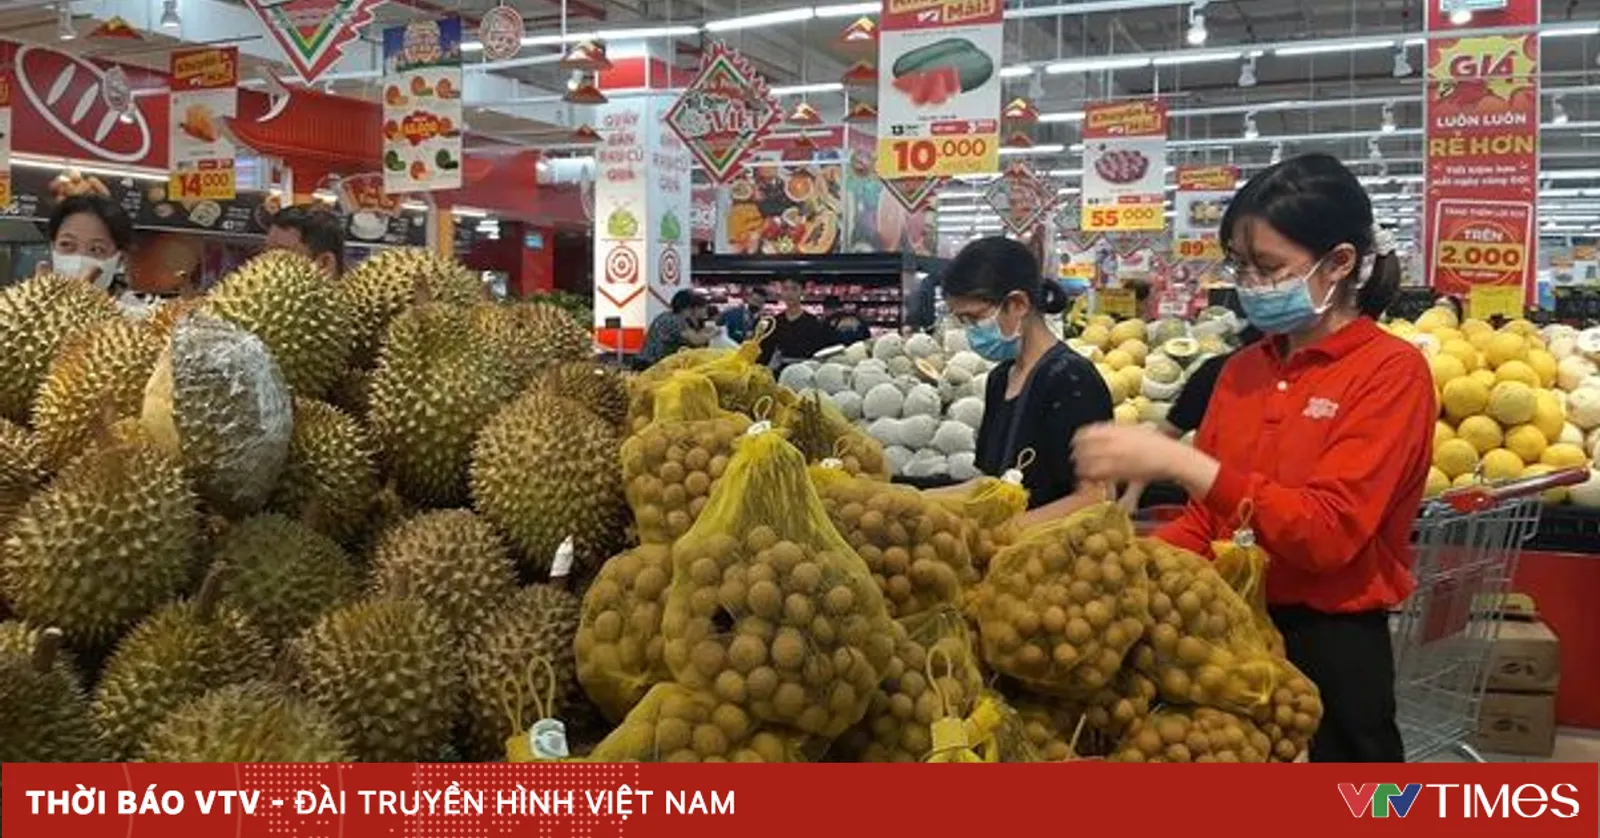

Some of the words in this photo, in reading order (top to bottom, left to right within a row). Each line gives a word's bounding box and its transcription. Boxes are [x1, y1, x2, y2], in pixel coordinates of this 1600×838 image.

[1450, 49, 1517, 78] GIÁ
[1437, 113, 1479, 128] LUÔN
[1482, 110, 1527, 126] LUÔN
[1430, 130, 1465, 157] RẺ
[1470, 134, 1534, 155] HƠN
[1464, 227, 1504, 242] TRÊN
[1439, 245, 1521, 267] 2.000
